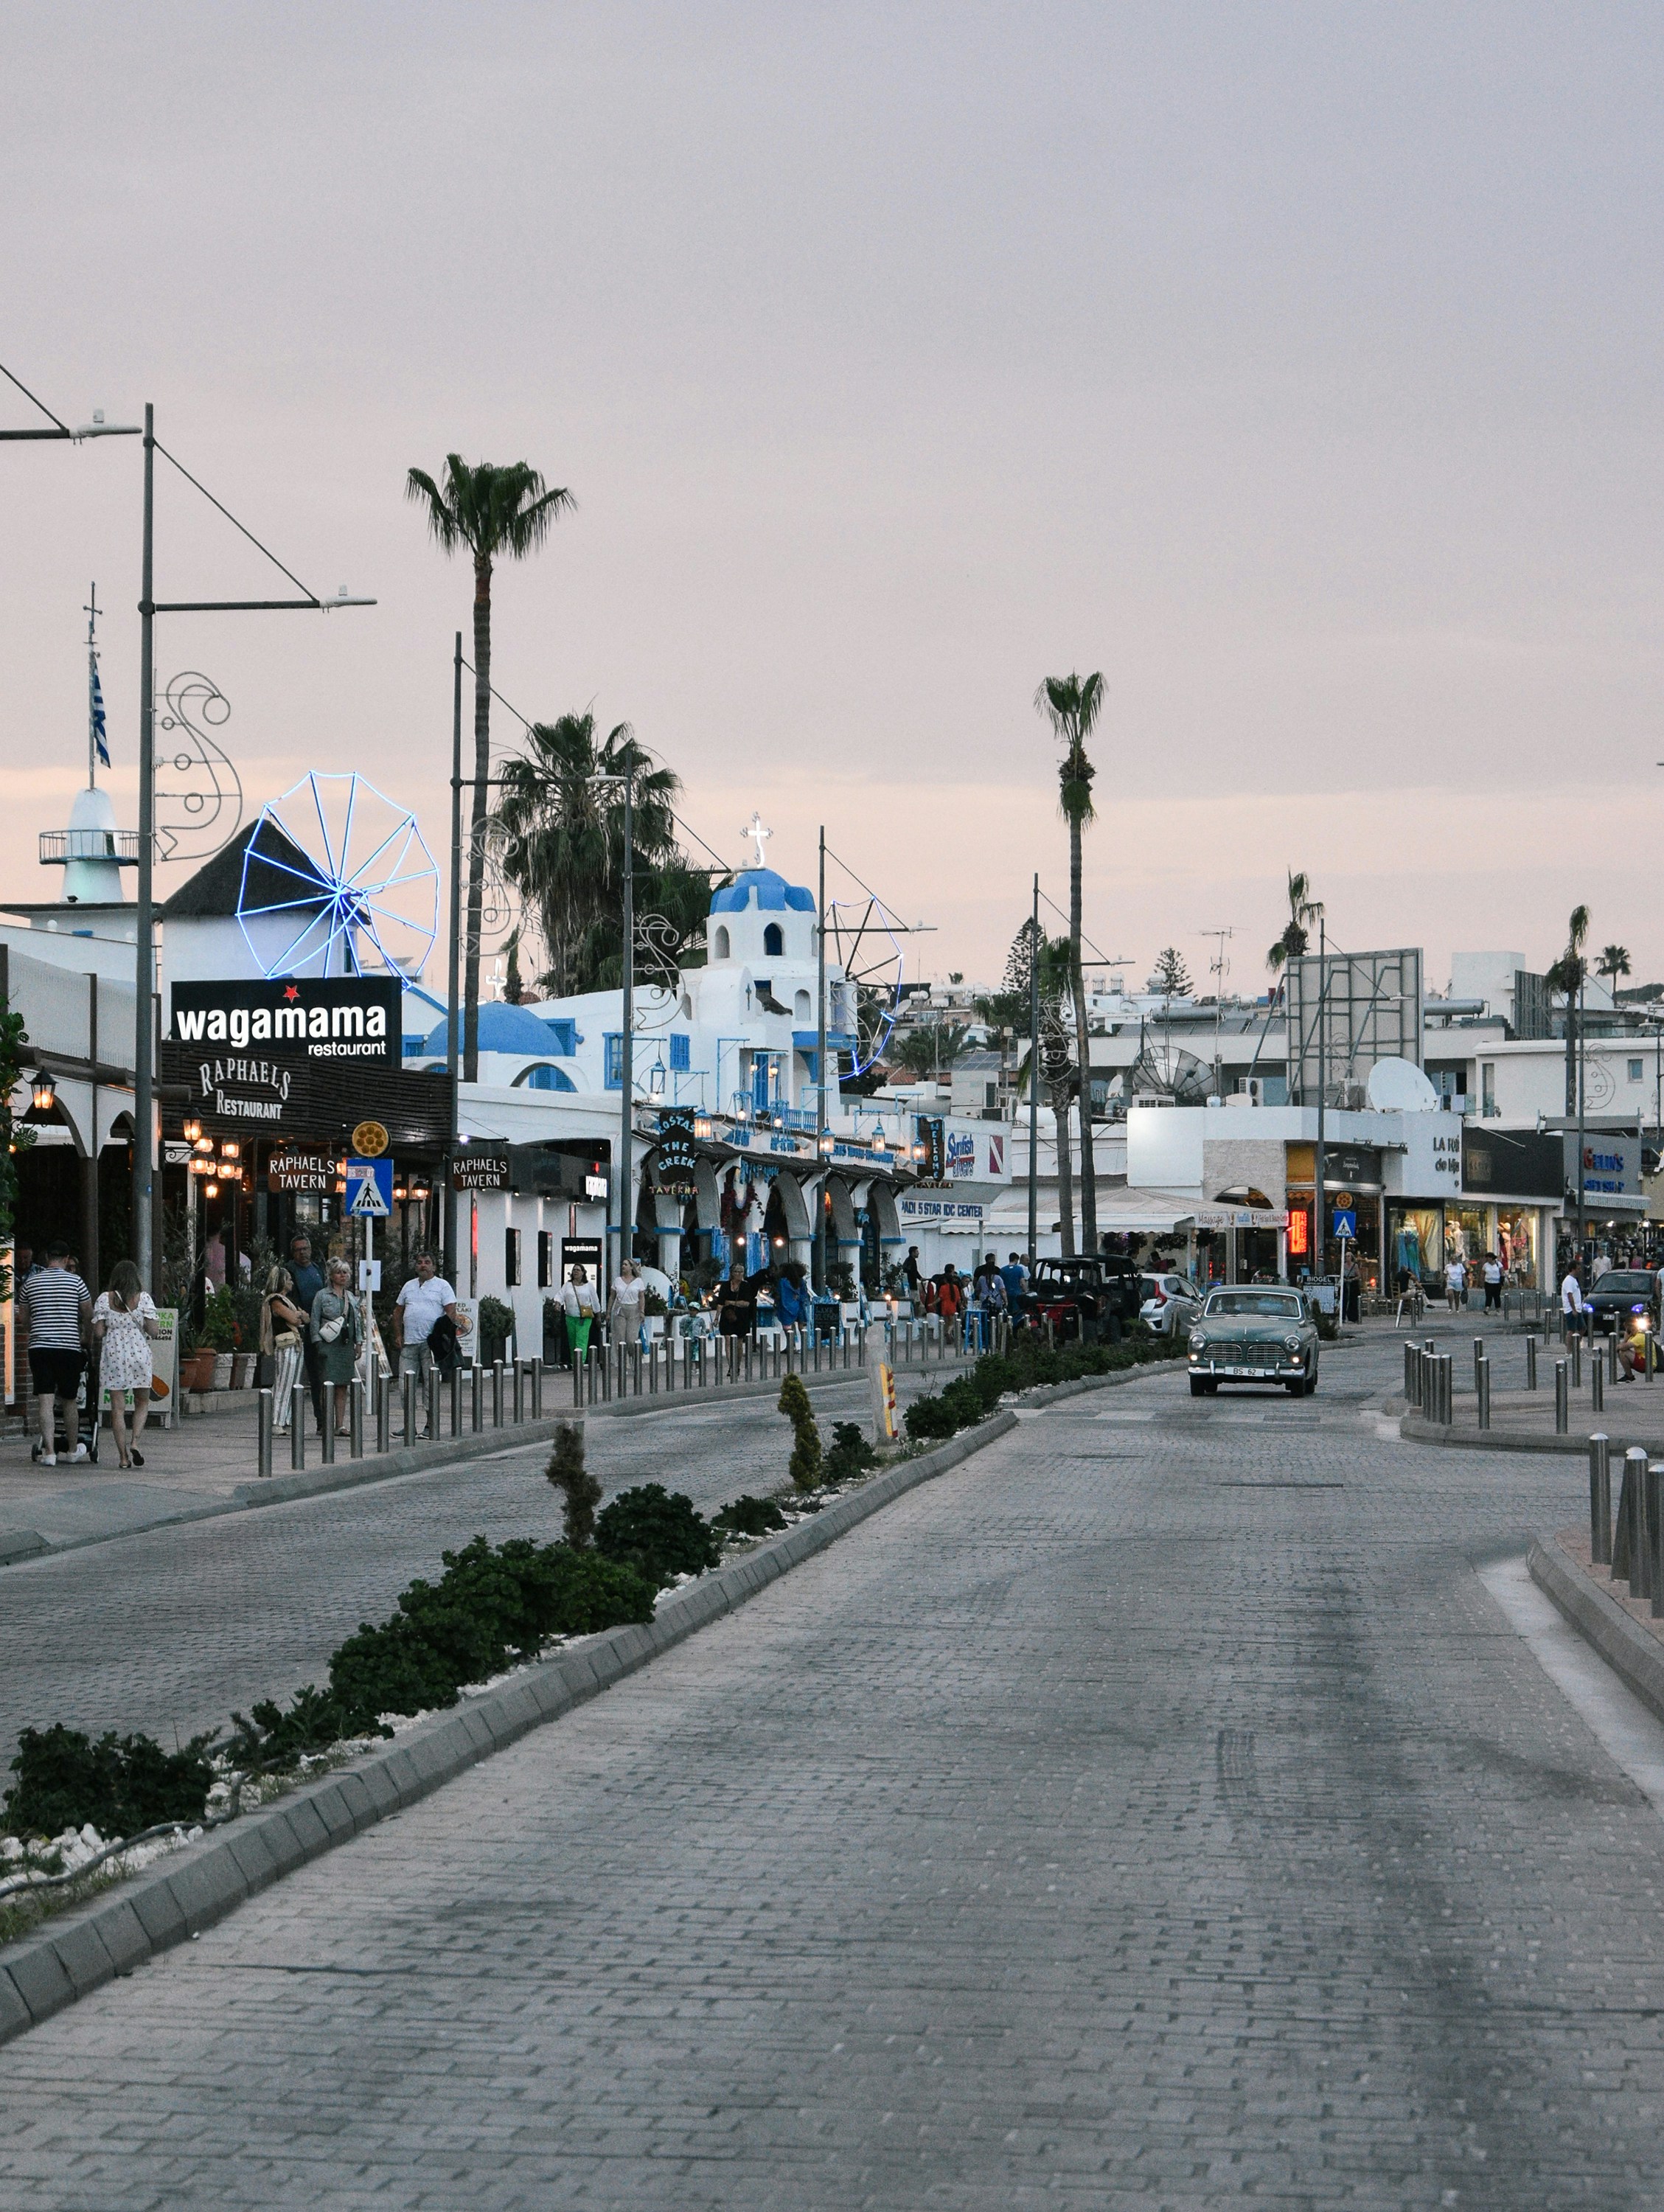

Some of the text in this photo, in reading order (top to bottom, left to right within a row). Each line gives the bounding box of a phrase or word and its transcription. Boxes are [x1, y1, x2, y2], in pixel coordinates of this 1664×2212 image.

[176, 1005, 386, 1048] wagamama
[307, 1040, 386, 1057] restaurant
[199, 1058, 291, 1101] RAPHAELS
[215, 1089, 282, 1120] RESTAURANT
[661, 1141, 689, 1152] THE
[930, 1123, 939, 1179] WELCOME
[1433, 1136, 1445, 1151] LA
[270, 1156, 335, 1175] RAPHAELS
[453, 1158, 507, 1174] RAPHAELS
[658, 1155, 696, 1171] GREEK
[279, 1174, 327, 1189] TAVERN
[461, 1174, 501, 1187] TAVERN
[918, 1201, 924, 1215] 5
[924, 1202, 941, 1216] STAR
[944, 1203, 955, 1217] IDC
[958, 1204, 983, 1218] CENTER
